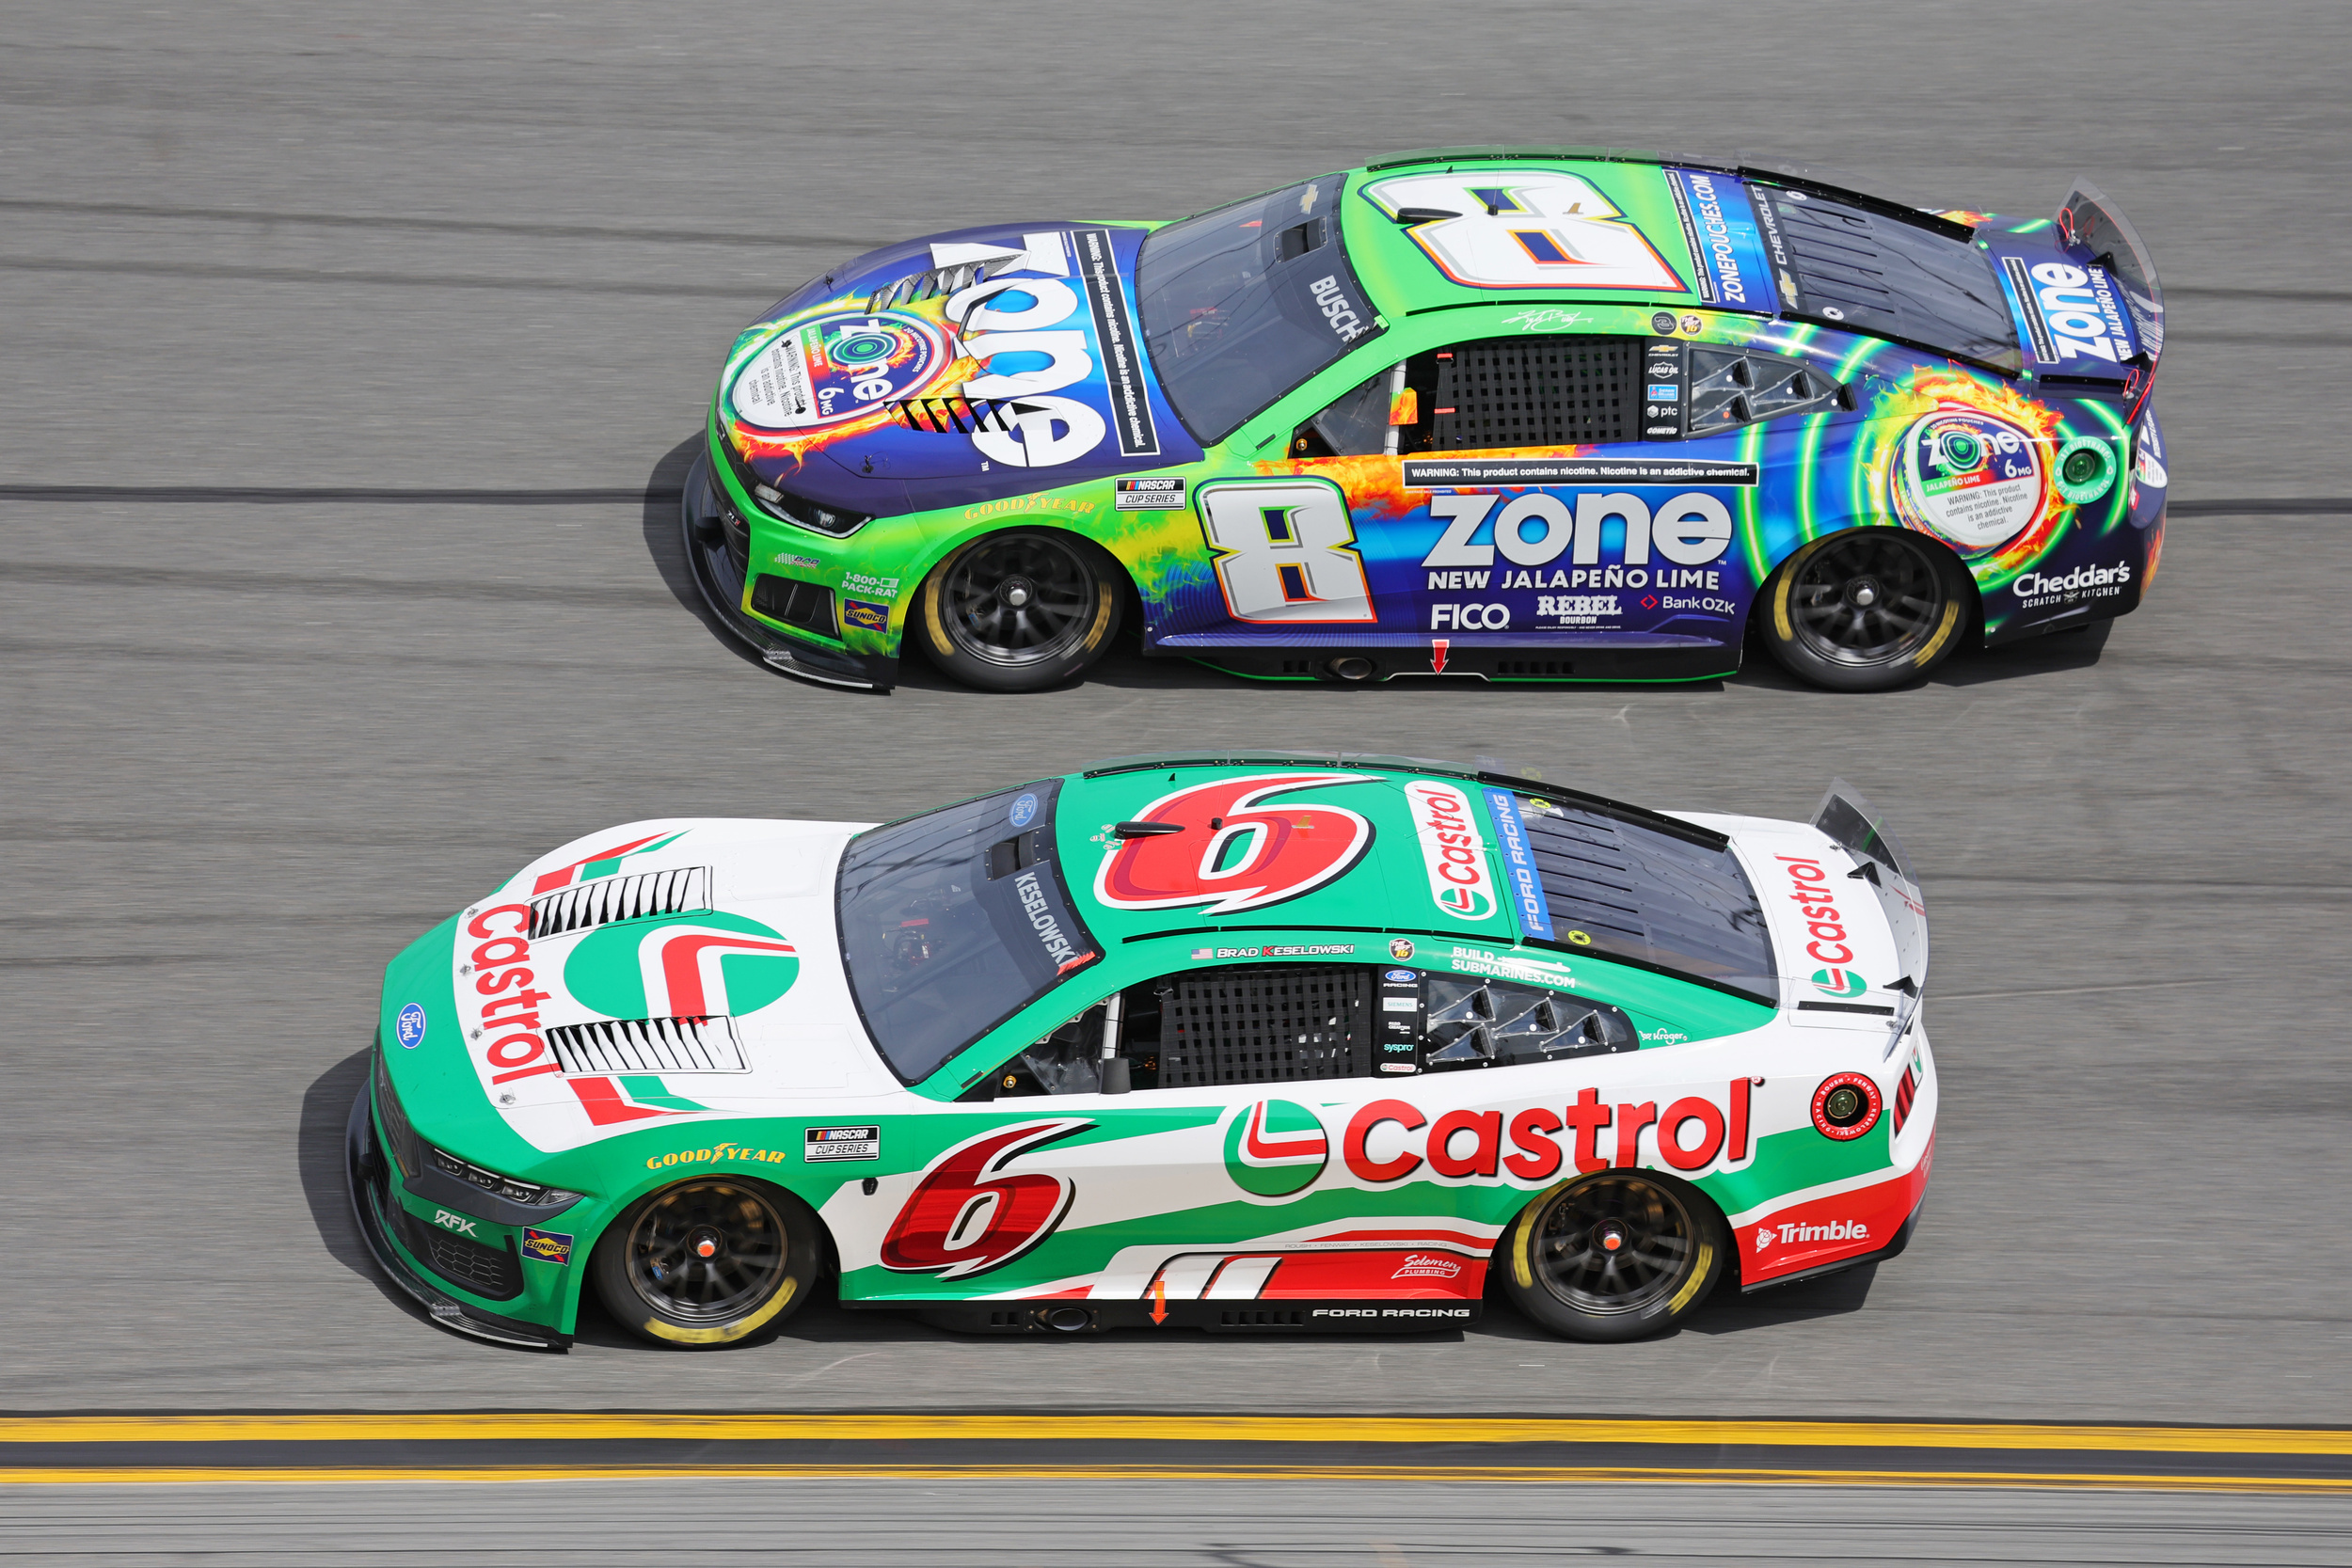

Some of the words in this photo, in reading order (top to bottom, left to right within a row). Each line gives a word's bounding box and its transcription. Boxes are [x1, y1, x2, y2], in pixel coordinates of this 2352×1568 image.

[1359, 170, 1689, 291] 8
[1751, 184, 1788, 265] CHEVROLET
[1086, 232, 1103, 261] WARNING:
[1690, 174, 1746, 304] ZONEPOUCHES.COM
[1093, 261, 1104, 275] This
[2089, 267, 2109, 290] LIME
[1102, 293, 1116, 319] contains
[1310, 275, 1369, 342] BUSCH
[2031, 262, 2118, 363] zone
[2095, 289, 2127, 337] JALAPEÑO
[806, 327, 821, 356] JALAPEÑO
[930, 231, 1106, 467] zone
[2113, 339, 2134, 361] NEW
[812, 354, 823, 368] LIME
[1113, 343, 1128, 369] Nicotine
[1120, 375, 1130, 385] an
[818, 388, 845, 400] 6
[1122, 384, 1137, 417] addictive
[820, 399, 834, 416] MG
[1661, 406, 1678, 418] ptc
[1129, 417, 1146, 448] chemical.
[1411, 468, 1459, 477] WARNING:
[1462, 467, 1481, 476] This
[1484, 467, 1518, 478] product
[1520, 467, 1558, 476] contains
[1561, 467, 1598, 475] nicotine.
[1600, 467, 1638, 475] Nicotine
[1639, 467, 1648, 475] is
[1663, 467, 1705, 476] addictive
[1707, 467, 1750, 476] chemical.
[2005, 459, 2018, 478] 6
[2017, 467, 2032, 477] MG
[1136, 480, 1176, 491] NASCAR
[1926, 477, 1963, 493] JALAPEÑO
[1963, 474, 1981, 485] LIME
[1947, 492, 1982, 506] WARNING:
[1983, 489, 1997, 498] This
[1998, 483, 2022, 496] product
[964, 492, 1095, 520] GOODYEAR
[1125, 495, 1144, 504] CUP
[1145, 494, 1176, 504] SERIES
[1946, 505, 1974, 517] contains
[1974, 499, 2002, 512] nicotine.
[2002, 492, 2028, 504] Nicotine
[1975, 512, 1983, 520] an
[1984, 505, 2013, 518] addictive
[1977, 516, 2009, 530] chemical.
[1422, 492, 1733, 567] zone
[1196, 478, 1376, 622] 8
[842, 580, 898, 598] PACK-RAT
[845, 571, 881, 587] 1-800-
[1428, 570, 1490, 590] NEW
[1501, 564, 1648, 590] JALAPEÑO
[1656, 569, 1720, 591] LIME
[2012, 561, 2131, 597] Cheddar's
[1536, 594, 1623, 616] REBEL
[1662, 595, 1700, 610] Bank
[1702, 597, 1736, 615] OZK
[2022, 594, 2061, 609] SCRATCH
[2081, 587, 2121, 599] KITCHEN
[846, 609, 887, 624] SUNOCO
[1430, 603, 1511, 630] FICO
[1559, 616, 1597, 625] BOURBON
[1014, 800, 1034, 821] Ford
[1414, 788, 1481, 885] Castrol
[1493, 794, 1528, 865] RACING
[1093, 773, 1388, 915] 6
[1516, 867, 1545, 932] FORD
[1773, 854, 1853, 964] Castrol
[1014, 871, 1078, 967] KESELOWSKI
[1216, 947, 1259, 958] BRAD
[1262, 944, 1355, 958] KESELOWSKI
[1452, 946, 1495, 962] BUILD
[1391, 972, 1411, 980] Ford
[1451, 959, 1576, 989] SUBMARINES.COM
[467, 904, 563, 1085] Castrol
[400, 1011, 421, 1041] Ford
[1653, 1027, 1684, 1045] Kroger
[1384, 1043, 1415, 1053] syspro
[1820, 1078, 1844, 1096] ROUSH
[1852, 1077, 1877, 1100] FENWAY
[1816, 1101, 1831, 1132] RACING
[1836, 1108, 1878, 1136] KESELOWSKI
[828, 1129, 869, 1140] NASCAR
[1343, 1077, 1754, 1182] Castrol
[646, 1142, 786, 1170] GOODYEAR
[815, 1145, 834, 1154] CUP
[836, 1144, 868, 1153] SERIES
[880, 1117, 1101, 1282] 6
[434, 1210, 478, 1238] RFK
[1777, 1220, 1867, 1243] Trimble
[526, 1239, 569, 1254] SUNOCO
[1404, 1255, 1461, 1270] Solomon
[1382, 1308, 1470, 1317] RACING
